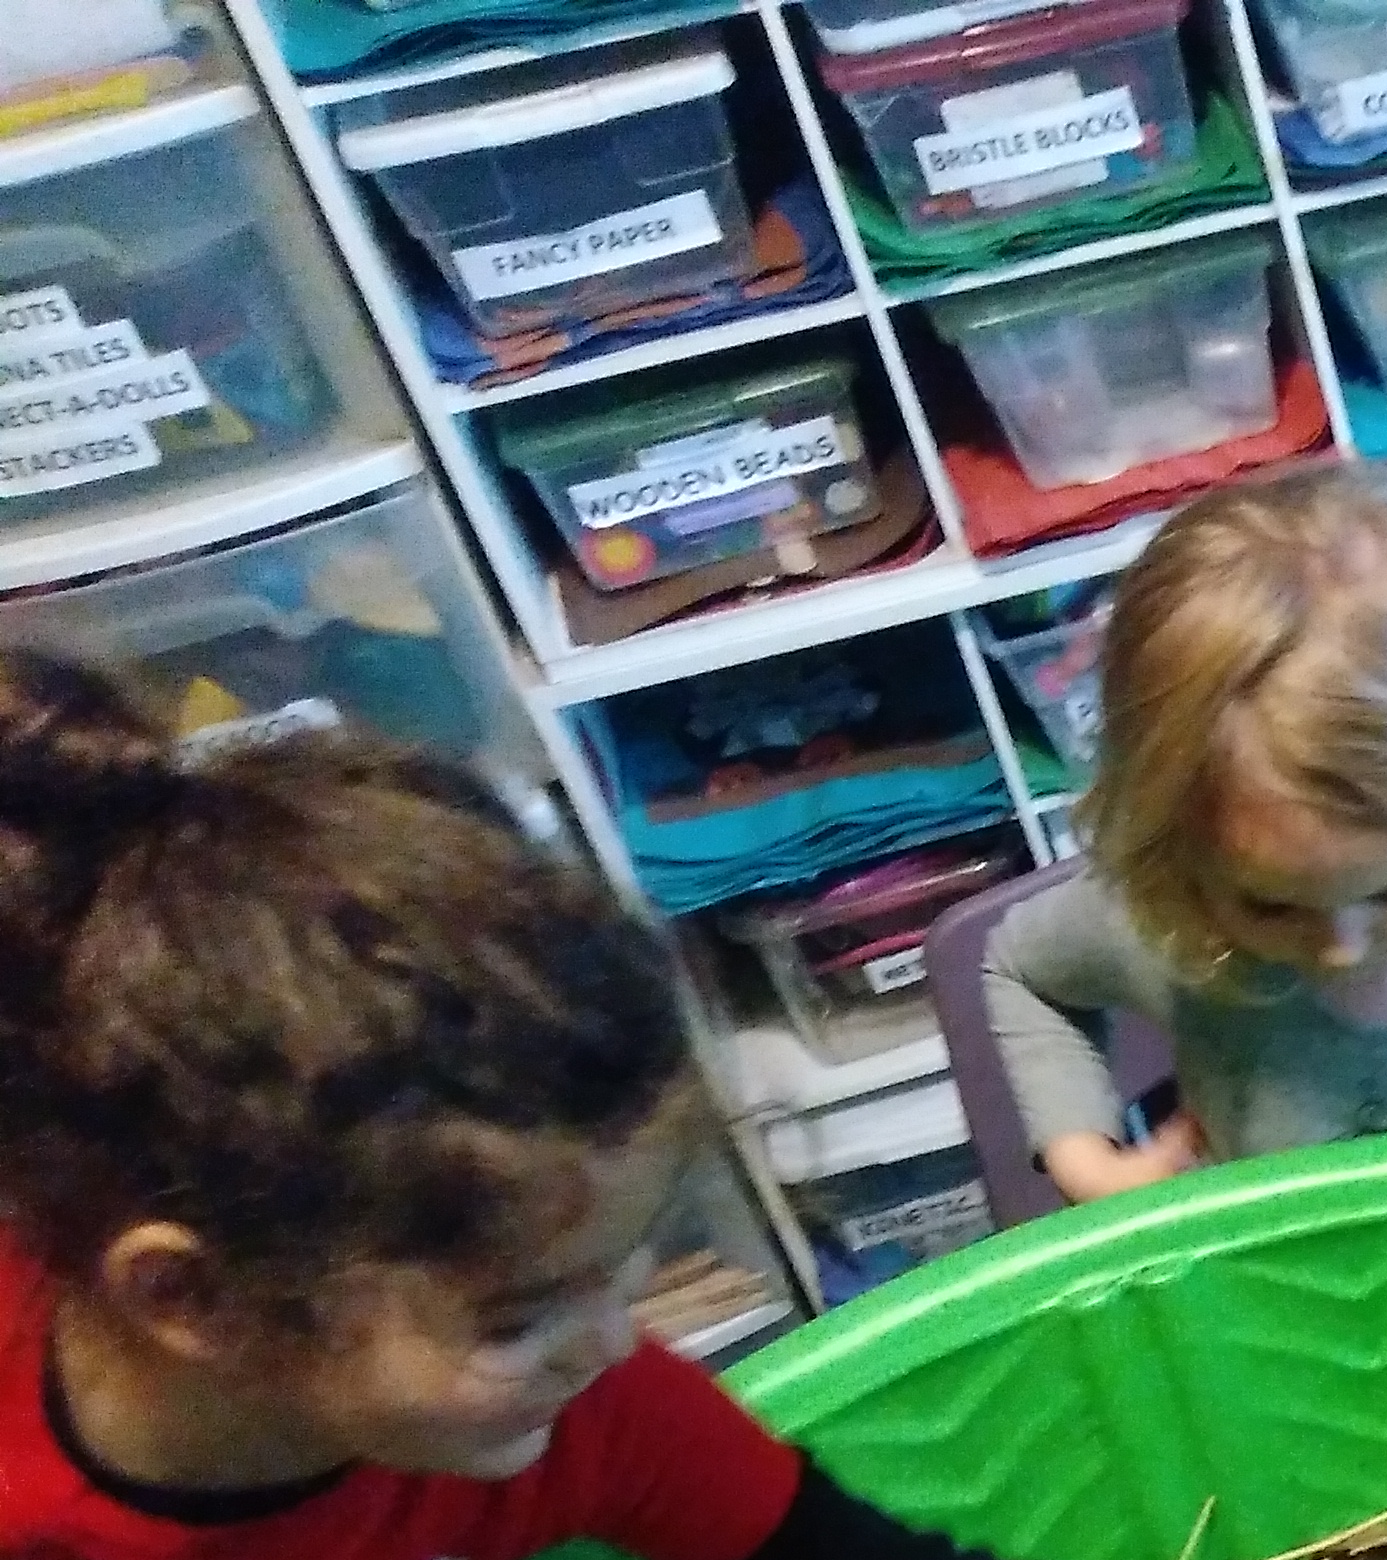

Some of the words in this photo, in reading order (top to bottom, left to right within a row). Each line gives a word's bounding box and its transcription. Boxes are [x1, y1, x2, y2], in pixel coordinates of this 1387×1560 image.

[928, 132, 1028, 172] BRISTLE
[1033, 108, 1130, 150] BLOCKS
[491, 239, 581, 277] FANCY
[587, 217, 676, 256] PAPER
[49, 337, 131, 374] TILES
[587, 463, 727, 520] WOODEN
[734, 433, 835, 481] BEADS
